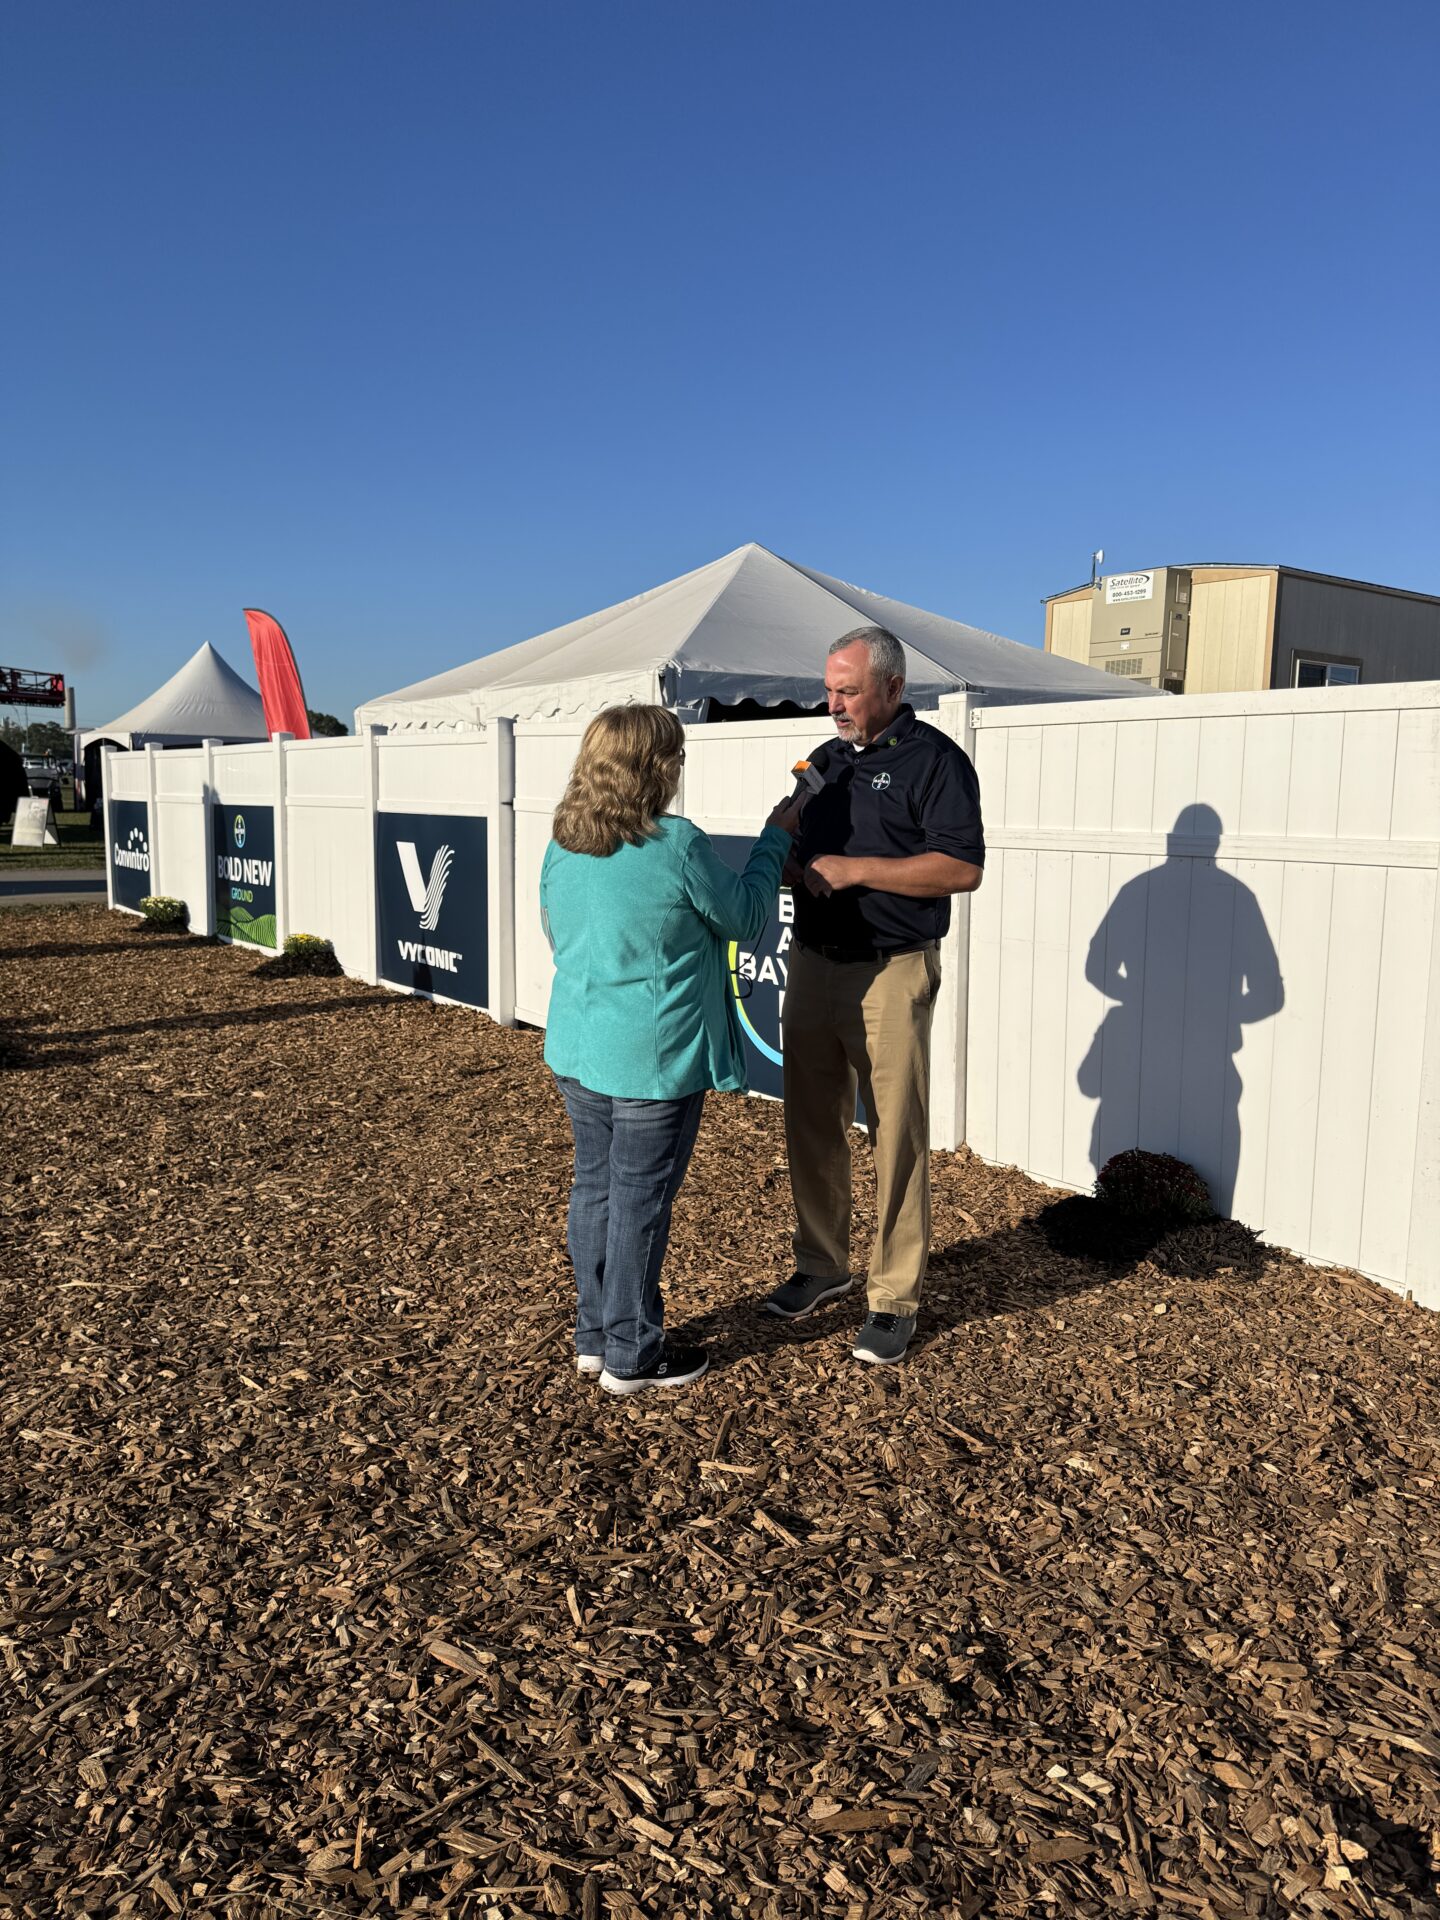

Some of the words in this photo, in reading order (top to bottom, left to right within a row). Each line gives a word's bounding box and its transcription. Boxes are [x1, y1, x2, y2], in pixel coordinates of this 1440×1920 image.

[1110, 576, 1144, 587] Satellite
[114, 842, 150, 872] Convintro
[217, 854, 242, 882] BOLD
[243, 857, 273, 887] NEW
[231, 887, 254, 903] GROUND
[738, 951, 788, 987] BAY
